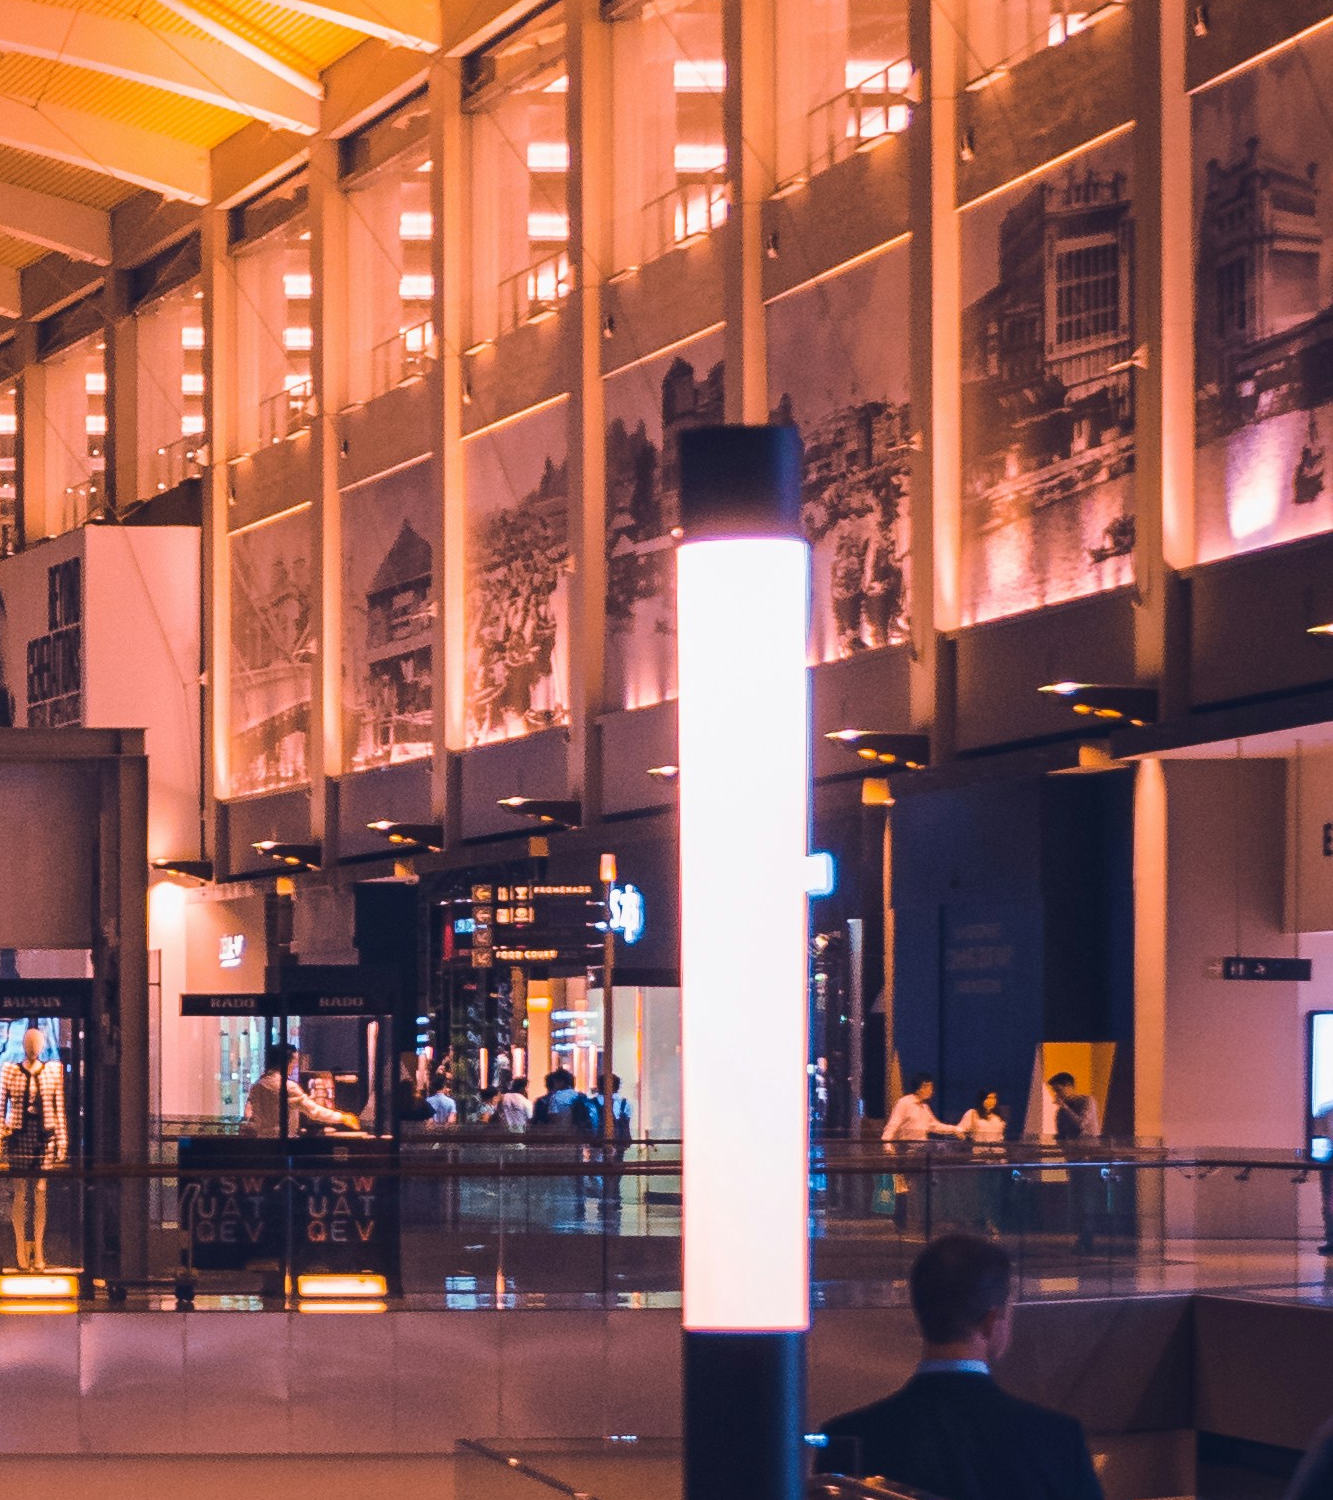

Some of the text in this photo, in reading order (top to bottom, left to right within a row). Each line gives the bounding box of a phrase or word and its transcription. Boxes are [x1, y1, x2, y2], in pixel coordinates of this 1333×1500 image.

[496, 949, 558, 960] FOOD COURT
[3, 996, 62, 1008] BALMAIN
[210, 997, 256, 1009] RADO
[319, 996, 365, 1008] RADO
